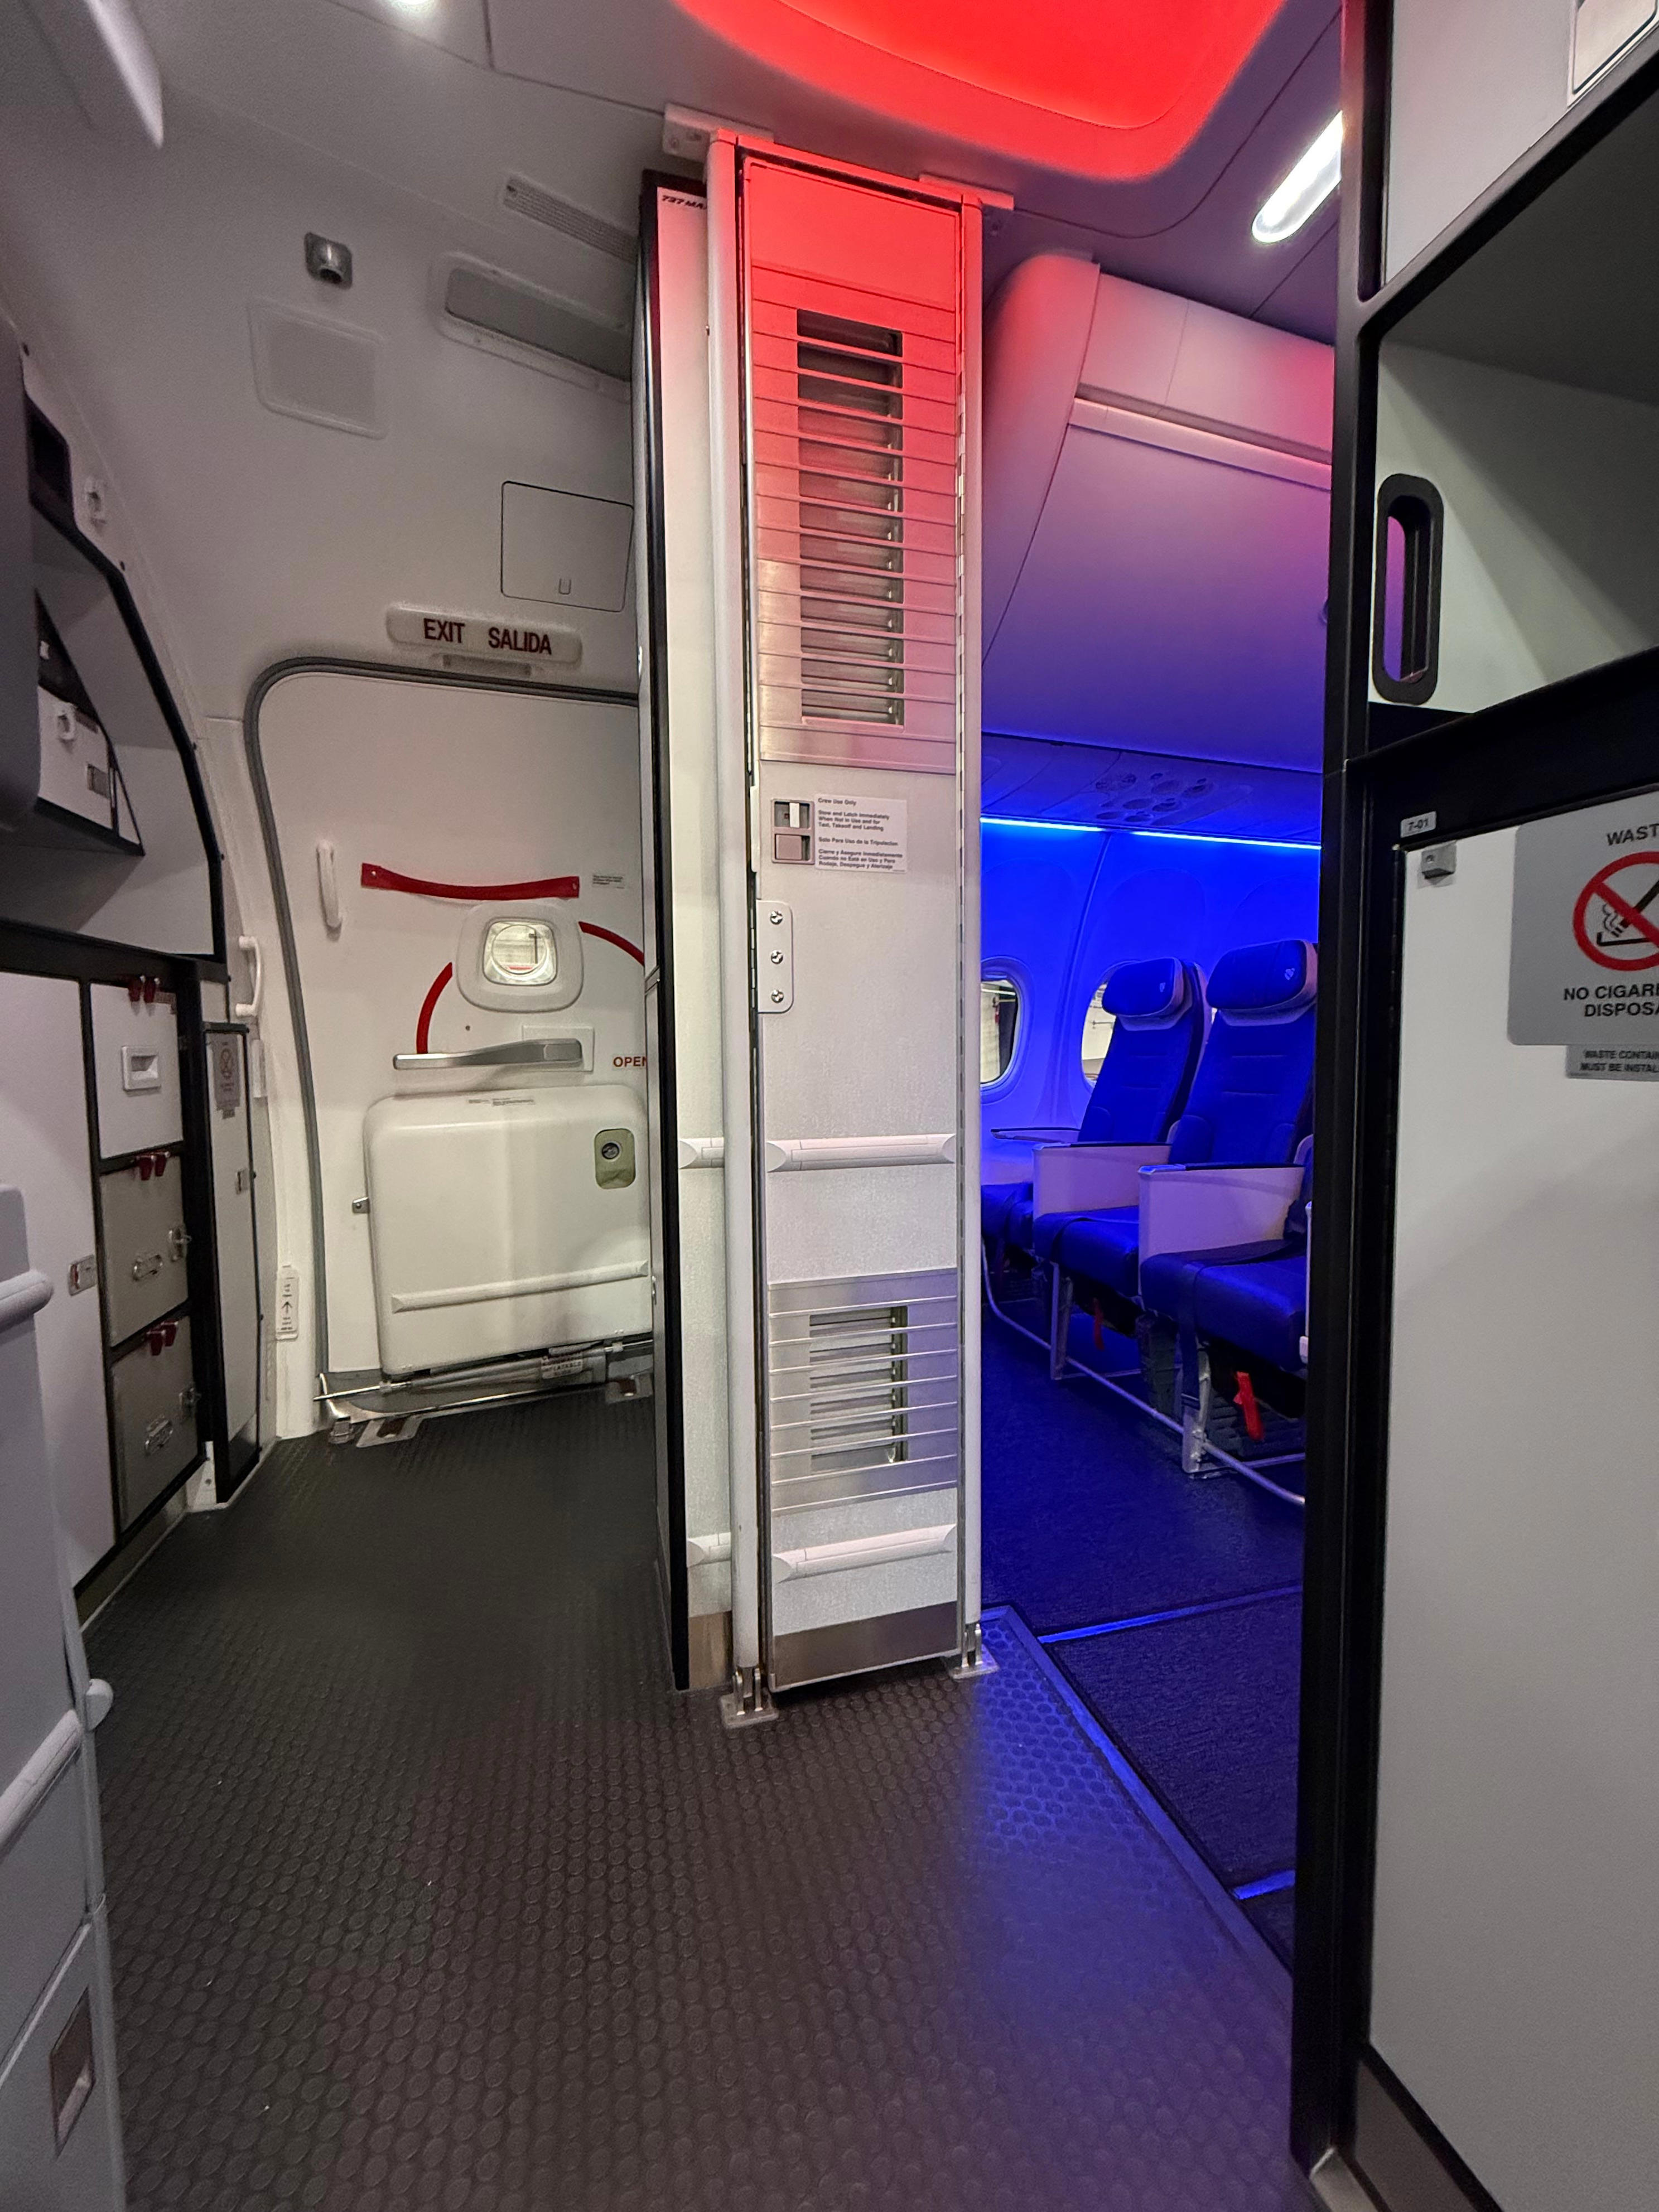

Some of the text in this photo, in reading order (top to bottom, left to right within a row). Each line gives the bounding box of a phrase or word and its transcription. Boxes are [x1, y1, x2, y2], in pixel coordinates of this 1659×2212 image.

[423, 617, 552, 655] EXIT SALIDA
[1563, 987, 1589, 1001] NO
[1608, 1062, 1622, 1071] BE
